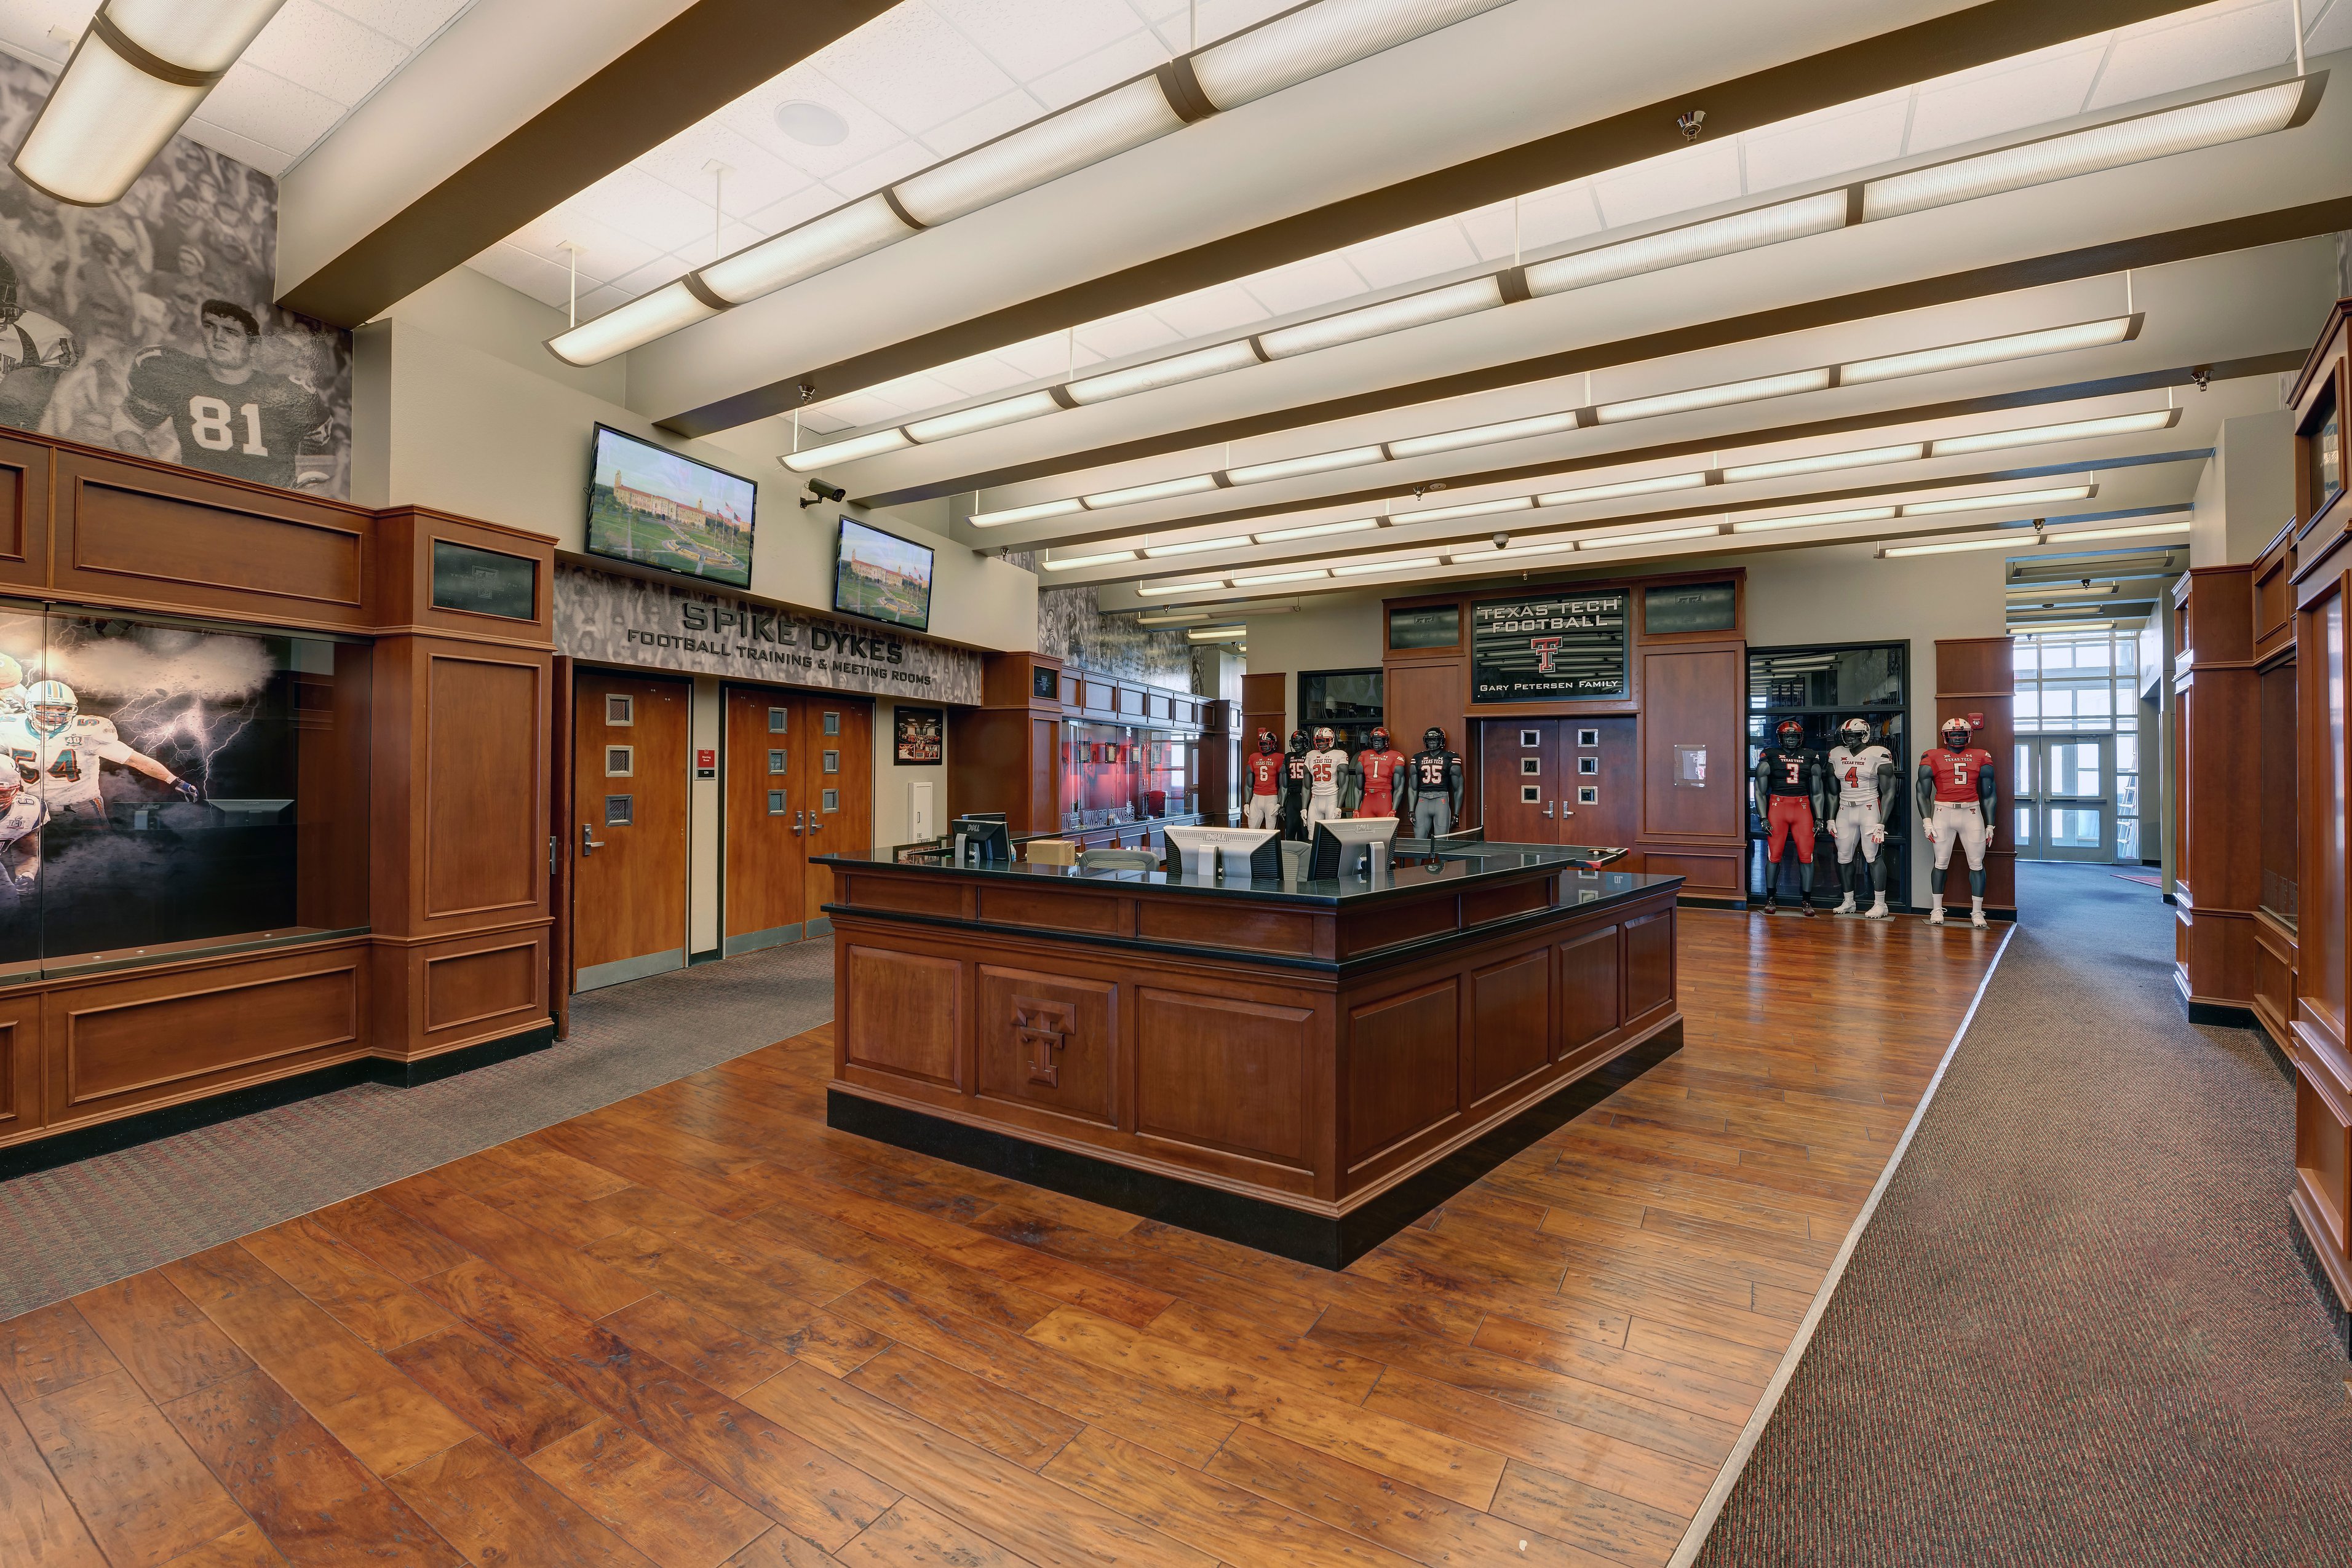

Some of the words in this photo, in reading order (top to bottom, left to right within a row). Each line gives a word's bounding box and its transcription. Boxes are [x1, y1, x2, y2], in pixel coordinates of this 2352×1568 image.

[189, 395, 268, 457] 81
[1480, 604, 1548, 620] TEXAS
[1557, 599, 1618, 614] TECH
[683, 602, 797, 646] SPIKE
[812, 627, 904, 663] DYKES
[1493, 615, 1608, 633] FOOTBALL
[627, 628, 731, 656] FOOTBALL
[737, 646, 812, 667] TRAINING
[818, 659, 827, 669] &
[832, 660, 887, 679] MEETING
[892, 670, 931, 685] ROOMS
[1514, 681, 1573, 690] PETERSEN
[11, 748, 82, 784] 54
[1259, 766, 1268, 782] 6
[1289, 762, 1304, 779] 35
[1313, 764, 1332, 782] 25
[1373, 761, 1379, 778] 1
[1421, 765, 1442, 784] 35
[1786, 762, 1800, 783] 3
[1953, 762, 1968, 785] 5
[1845, 766, 1859, 788] 4
